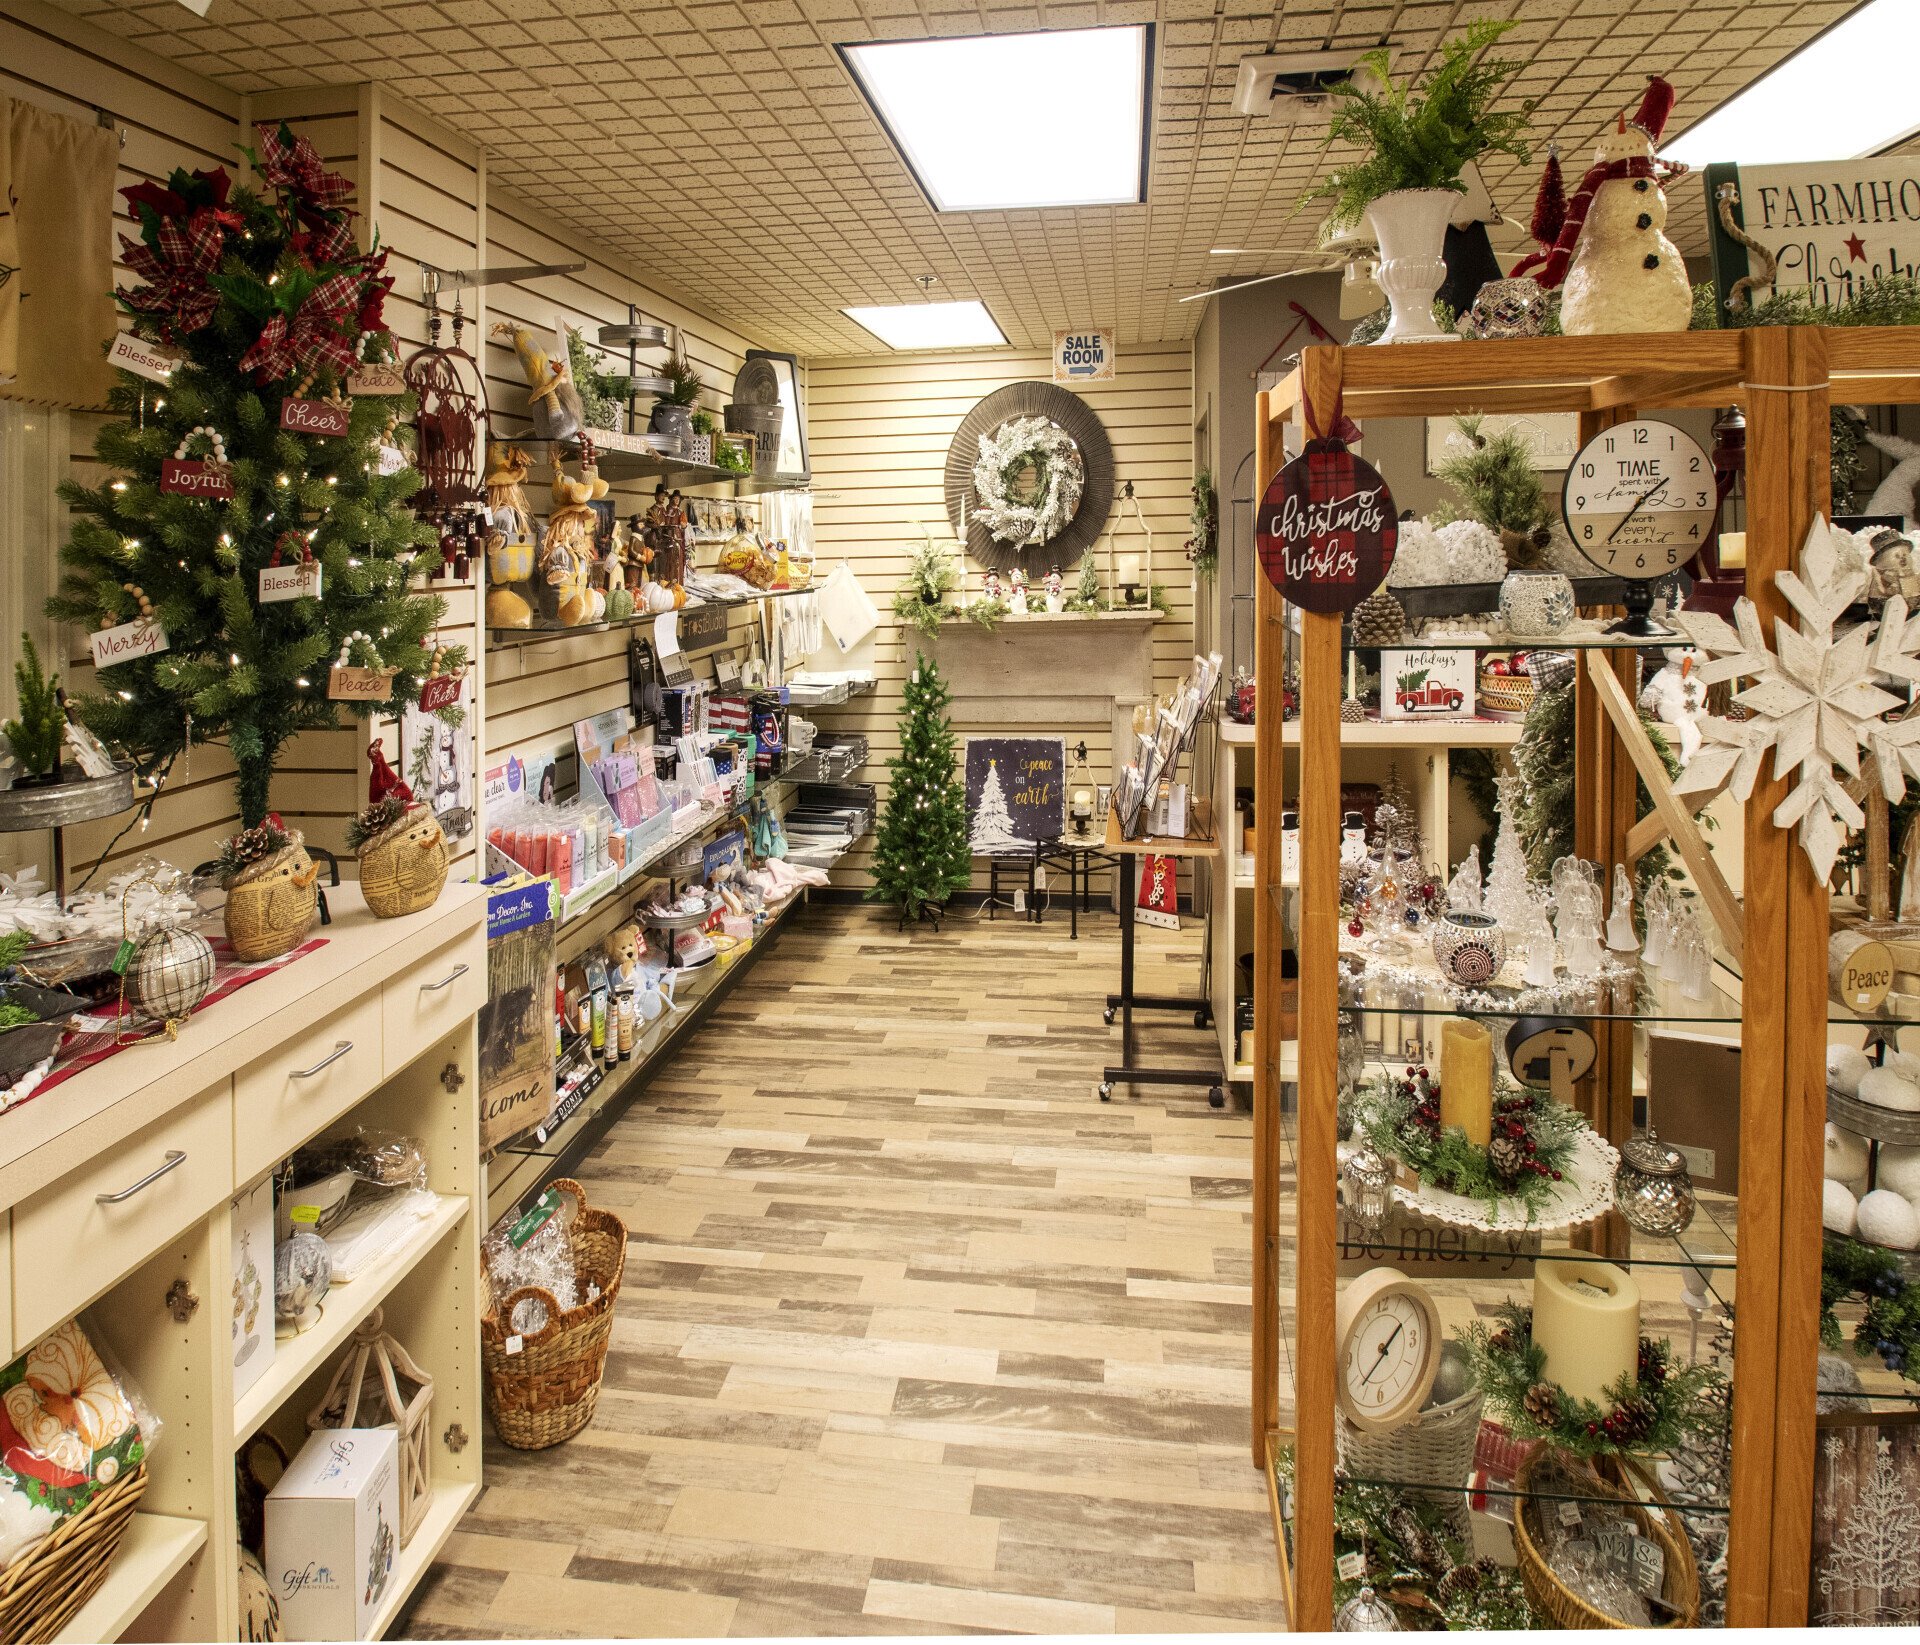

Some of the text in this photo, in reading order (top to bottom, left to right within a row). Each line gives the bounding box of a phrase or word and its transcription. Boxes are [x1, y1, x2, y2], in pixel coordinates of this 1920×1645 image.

[1066, 335, 1101, 350] SALE
[116, 342, 173, 374] Blessed
[1062, 350, 1104, 365] ROOM
[285, 403, 342, 431] Cheer
[594, 430, 625, 452] GATHER
[1633, 428, 1649, 444] 12
[1669, 435, 1675, 451] 1
[1605, 437, 1615, 454] 11
[1581, 463, 1595, 479] 10
[1617, 459, 1661, 477] TIME
[1689, 457, 1700, 473] 2
[169, 468, 227, 490] Joyful
[1618, 477, 1662, 487] spent with
[1576, 495, 1586, 511] 9
[1594, 486, 1686, 509] family
[1696, 492, 1707, 508] 3
[1631, 514, 1656, 523] worth
[1583, 524, 1594, 540] 8
[1607, 532, 1675, 546] second
[1623, 527, 1657, 537] every
[1688, 523, 1699, 539] 4
[1607, 550, 1616, 565] 7
[1635, 553, 1645, 569] 6
[1666, 549, 1677, 564] 5
[263, 573, 311, 592] Blessed
[98, 628, 160, 659] Merry
[1405, 651, 1456, 669] Holidays
[337, 672, 384, 693] Peace
[427, 679, 459, 708] Cheer
[1022, 759, 1054, 778] peace
[1015, 776, 1025, 784] on
[1013, 783, 1054, 805] earth
[1846, 968, 1890, 991] Peace
[558, 1089, 582, 1116] DIONIS
[1341, 1221, 1386, 1261] Be
[1376, 1296, 1389, 1314] 12
[1409, 1329, 1417, 1348] 3
[1376, 1384, 1385, 1404] 6
[282, 1561, 315, 1601] Gift
